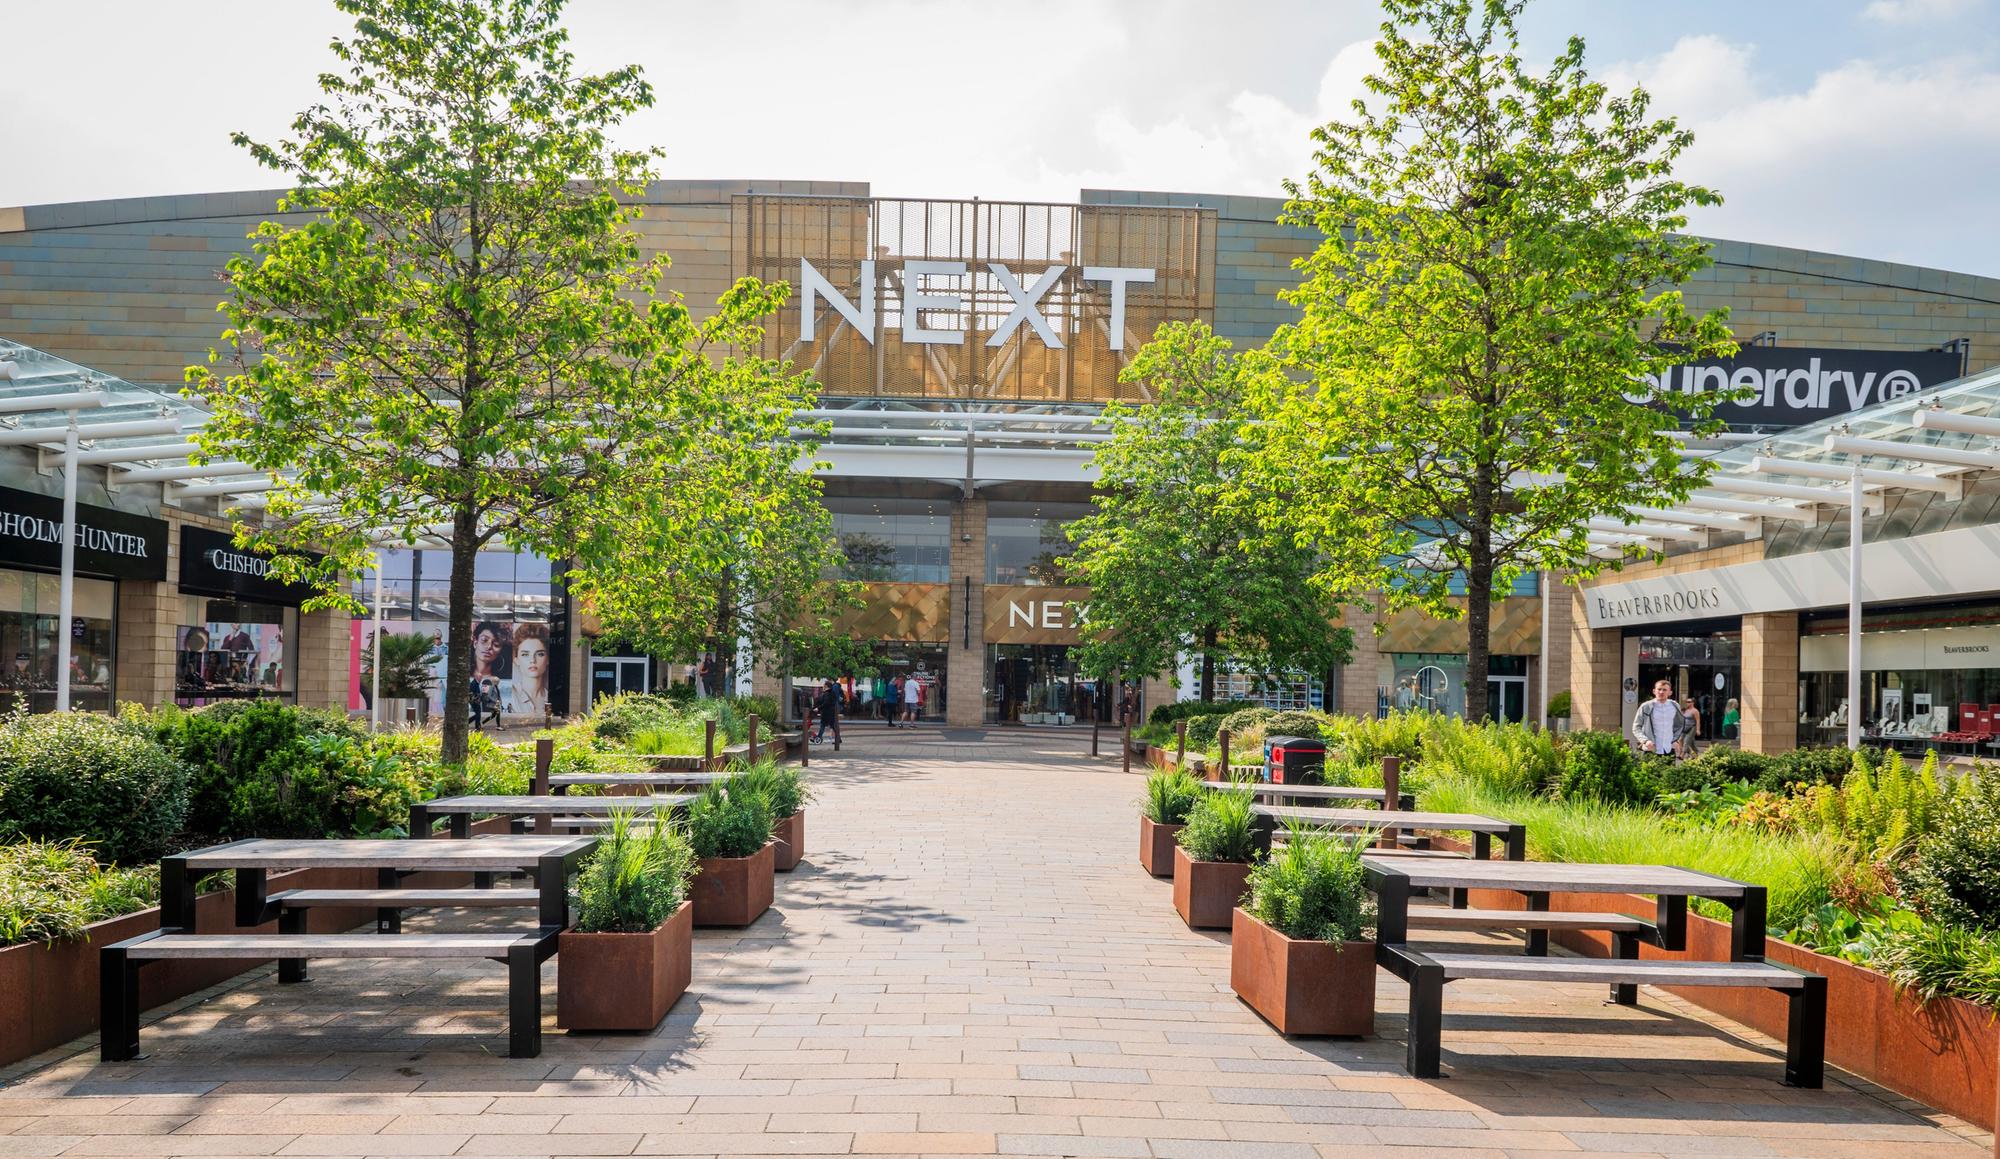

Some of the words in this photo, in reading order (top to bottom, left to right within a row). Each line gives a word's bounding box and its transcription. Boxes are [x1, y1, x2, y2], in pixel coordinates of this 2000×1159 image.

[801, 257, 1155, 350] NEXT
[0, 511, 64, 543] HOLM
[74, 523, 147, 557] HUNTER
[213, 549, 277, 577] CHISHOL
[1009, 601, 1114, 629] NEX
[1598, 587, 1720, 619] BEAVERBROOKS
